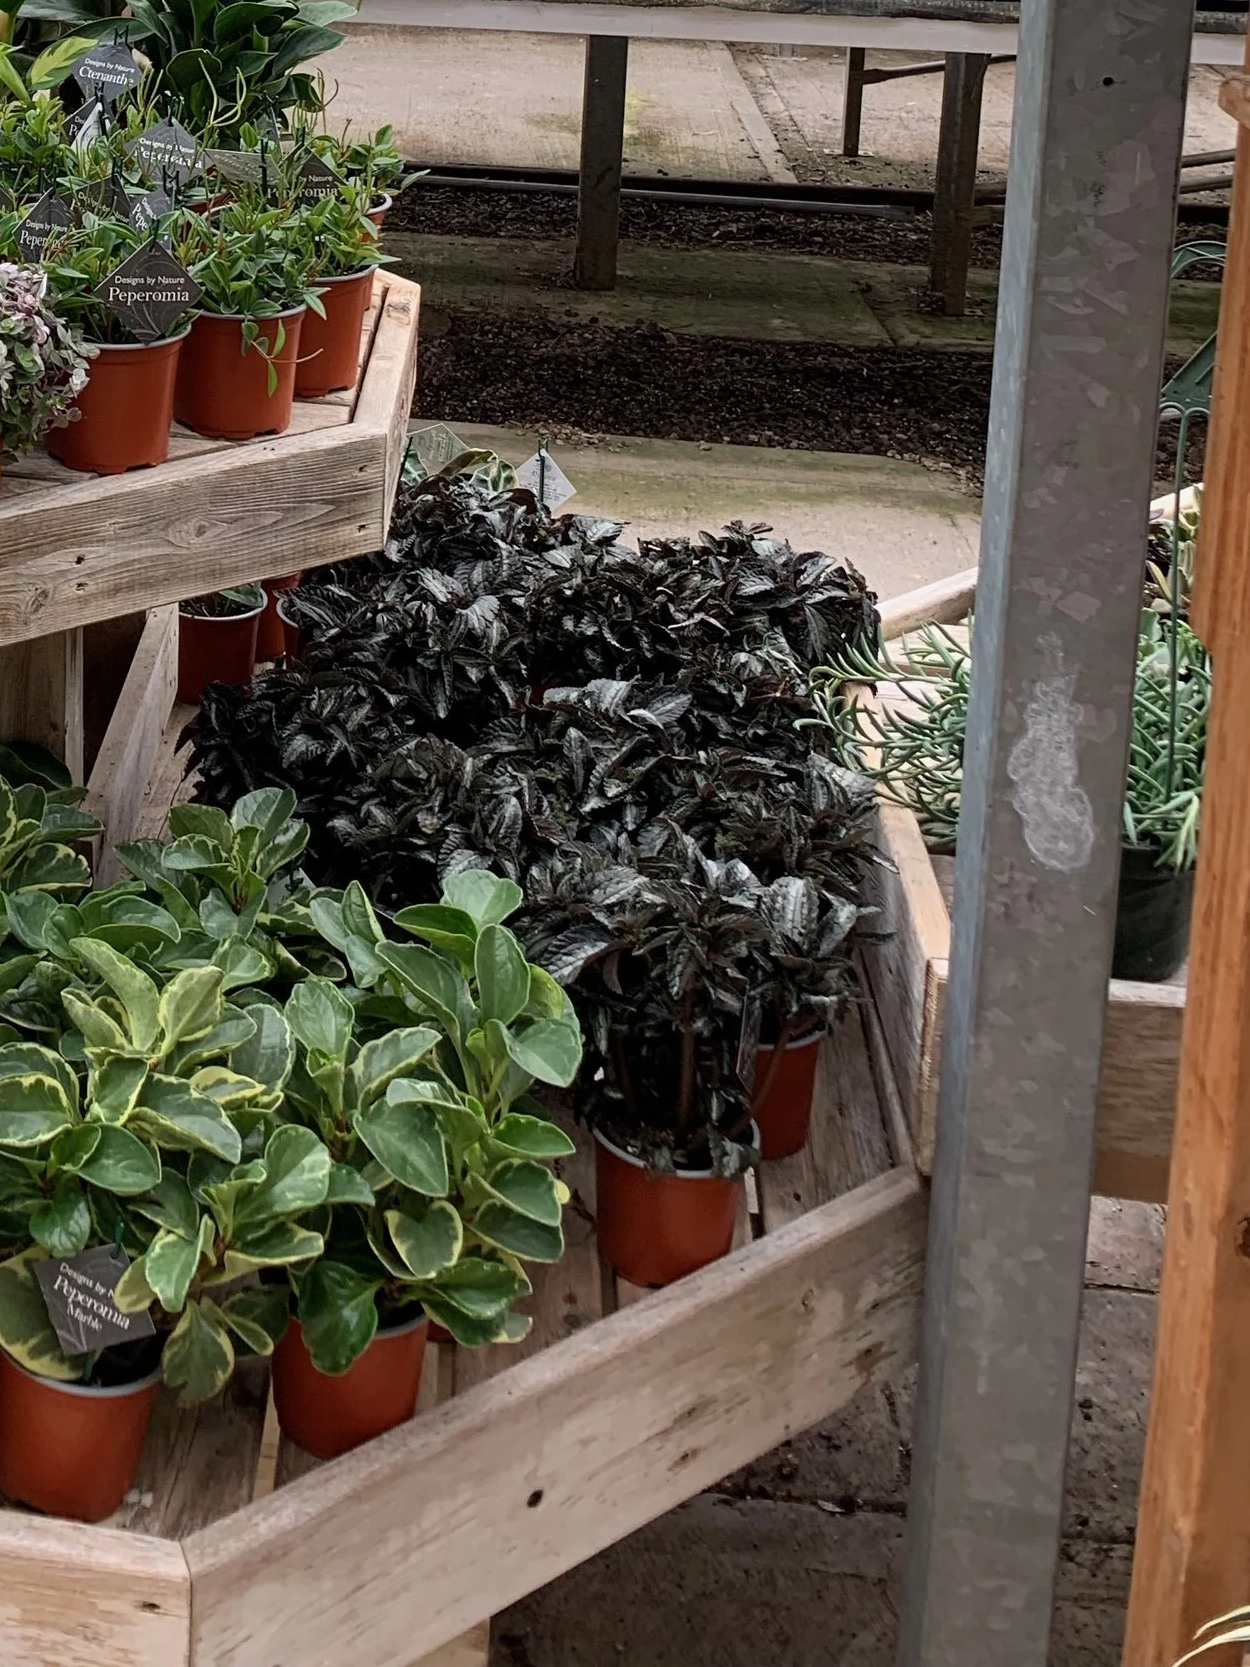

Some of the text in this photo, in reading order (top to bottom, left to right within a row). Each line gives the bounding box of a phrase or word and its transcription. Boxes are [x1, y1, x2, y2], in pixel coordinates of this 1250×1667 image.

[114, 275, 185, 286] Designs by Nature
[108, 286, 189, 306] Peperomia
[60, 1262, 94, 1288] Designs
[94, 1281, 107, 1295] by
[53, 1275, 131, 1330] Peperomia
[67, 1303, 103, 1331] Marble
